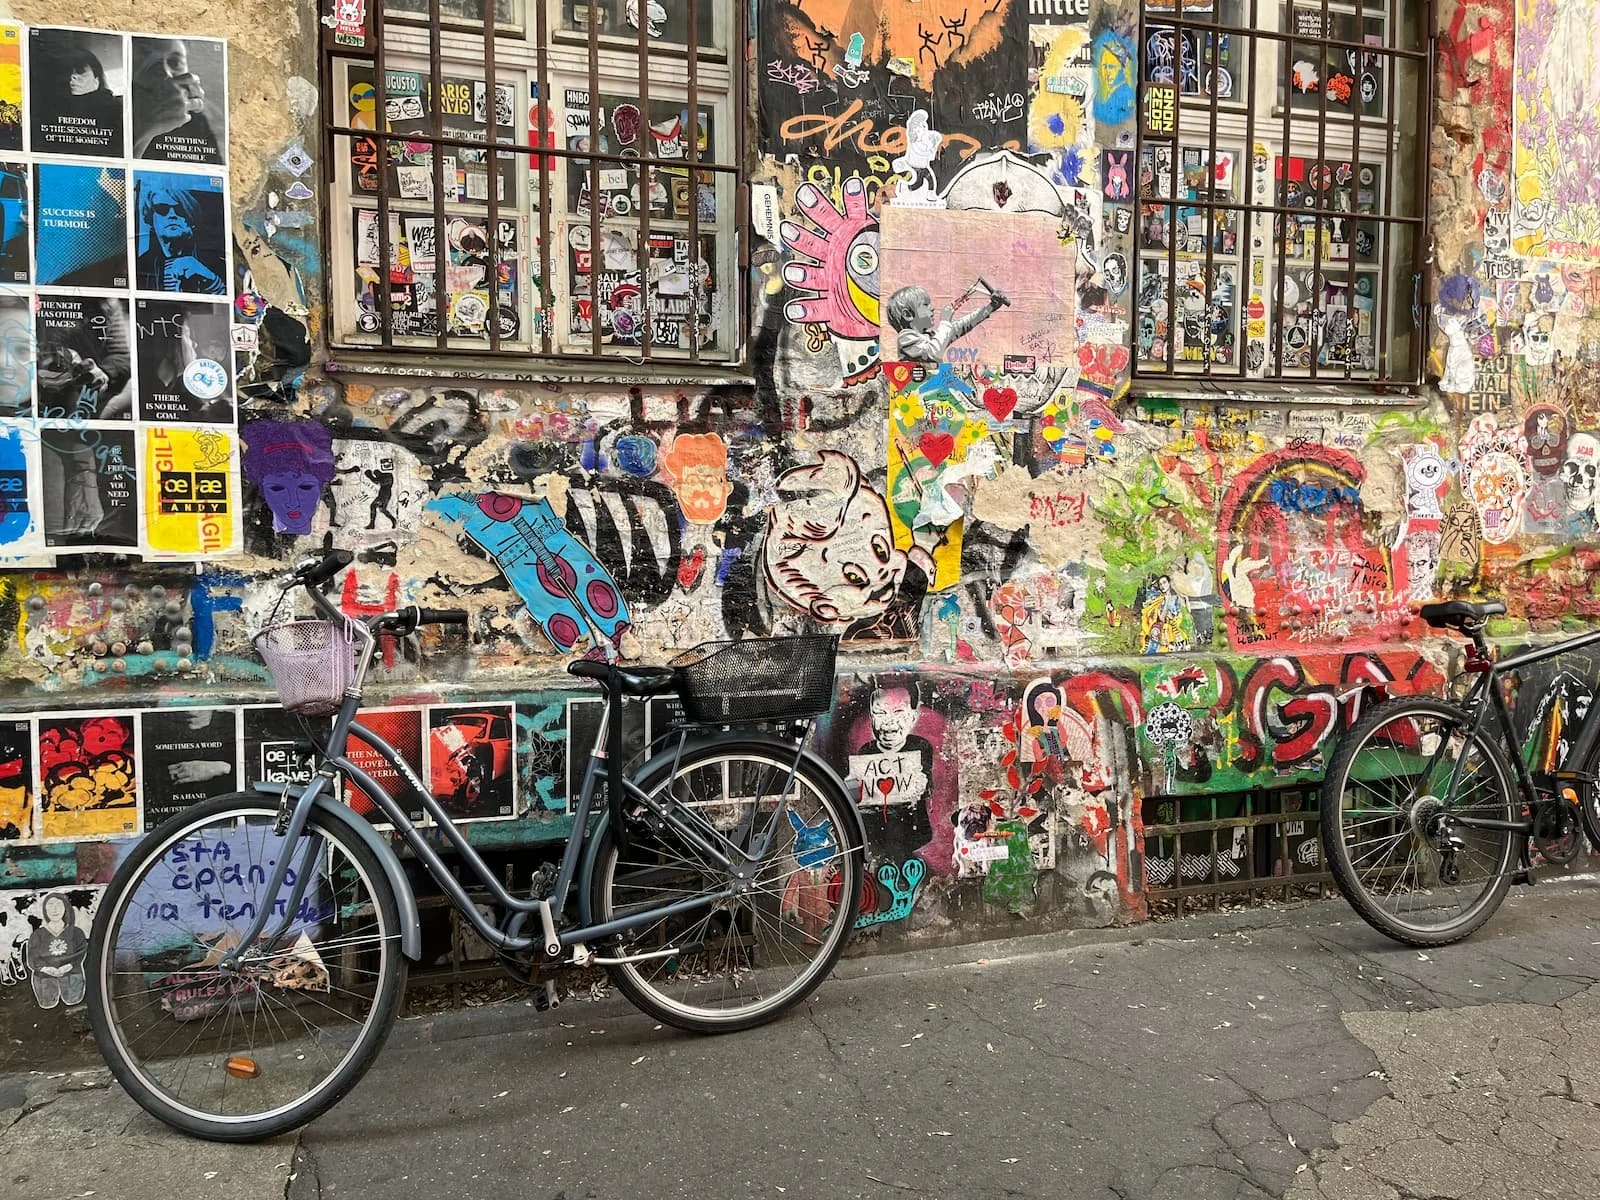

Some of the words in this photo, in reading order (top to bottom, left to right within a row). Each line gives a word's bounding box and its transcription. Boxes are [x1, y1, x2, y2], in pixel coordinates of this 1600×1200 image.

[385, 75, 416, 90] UGUSTO
[58, 116, 97, 126] FREEDOM
[40, 124, 48, 132] IS
[49, 125, 66, 134] THE
[66, 126, 114, 137] SENSUALITY
[46, 134, 56, 142] OF
[57, 134, 75, 144] THE
[75, 136, 110, 146] MOMENT
[164, 135, 208, 146] EVERYTHING
[155, 143, 163, 151] IS
[163, 143, 194, 152] POSSIBLE
[202, 146, 217, 154] THE
[167, 151, 207, 161] IMPOSSIBLE
[42, 208, 84, 218] SUCCESS
[86, 209, 96, 218] IS
[764, 192, 774, 240] GEHEIMNIS
[44, 218, 90, 229] TURMOIL
[38, 300, 55, 310] THE
[56, 301, 82, 311] NIGHT
[38, 310, 55, 318] HAS
[55, 311, 84, 320] OTHER
[45, 319, 76, 328] IMAGES
[946, 347, 979, 363] OXY
[153, 394, 180, 402] THERE
[146, 402, 154, 410] IS
[154, 403, 167, 411] NO
[167, 403, 189, 411] REAL
[112, 456, 123, 464] AS
[112, 473, 123, 481] AS
[110, 481, 126, 490] YOU
[108, 490, 129, 498] NEED
[171, 502, 219, 512] ANDY
[154, 743, 194, 751] SOMETIMES
[200, 741, 223, 749] WORD
[864, 756, 906, 778] ACT
[172, 793, 180, 801] IS
